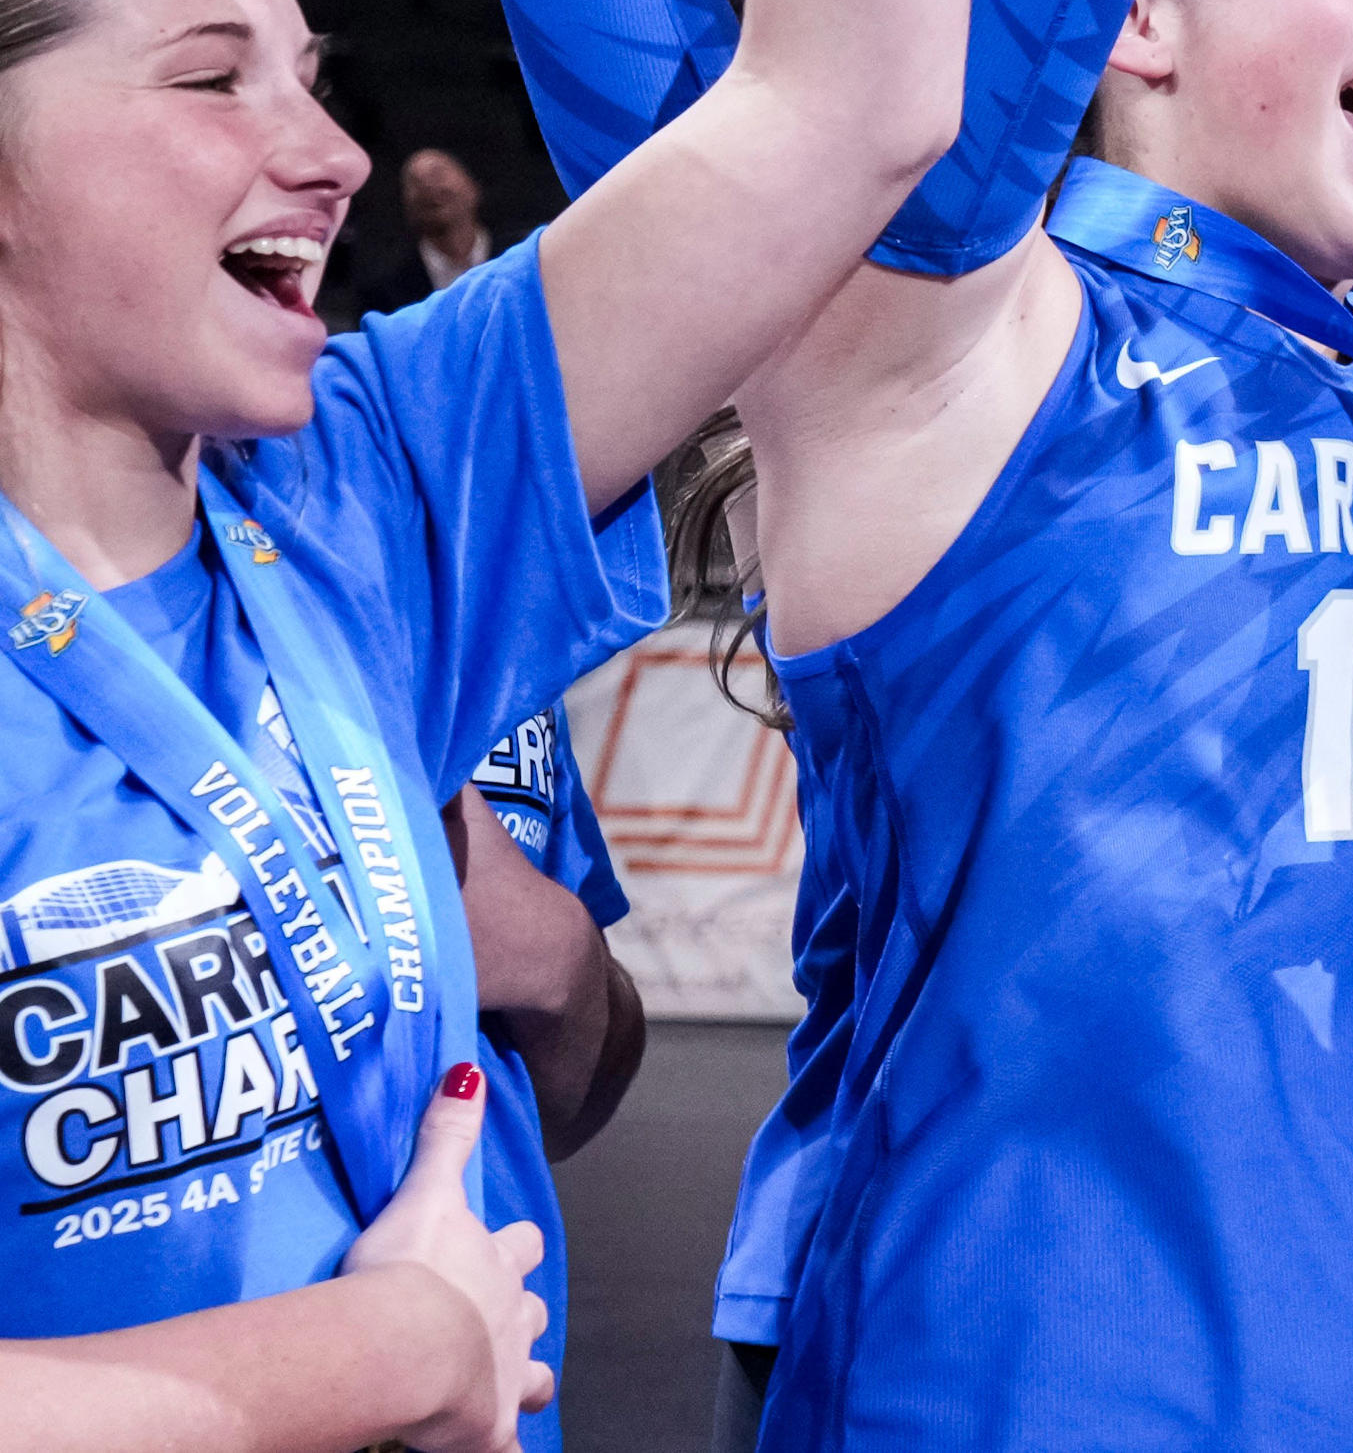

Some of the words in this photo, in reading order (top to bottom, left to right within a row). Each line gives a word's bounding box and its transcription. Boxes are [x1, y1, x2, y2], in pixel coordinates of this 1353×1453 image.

[190, 760, 375, 1062] VOLLEYBALL
[330, 766, 424, 1014] CHAMPION
[53, 1191, 172, 1250] 2025
[180, 1171, 241, 1213] 4A
